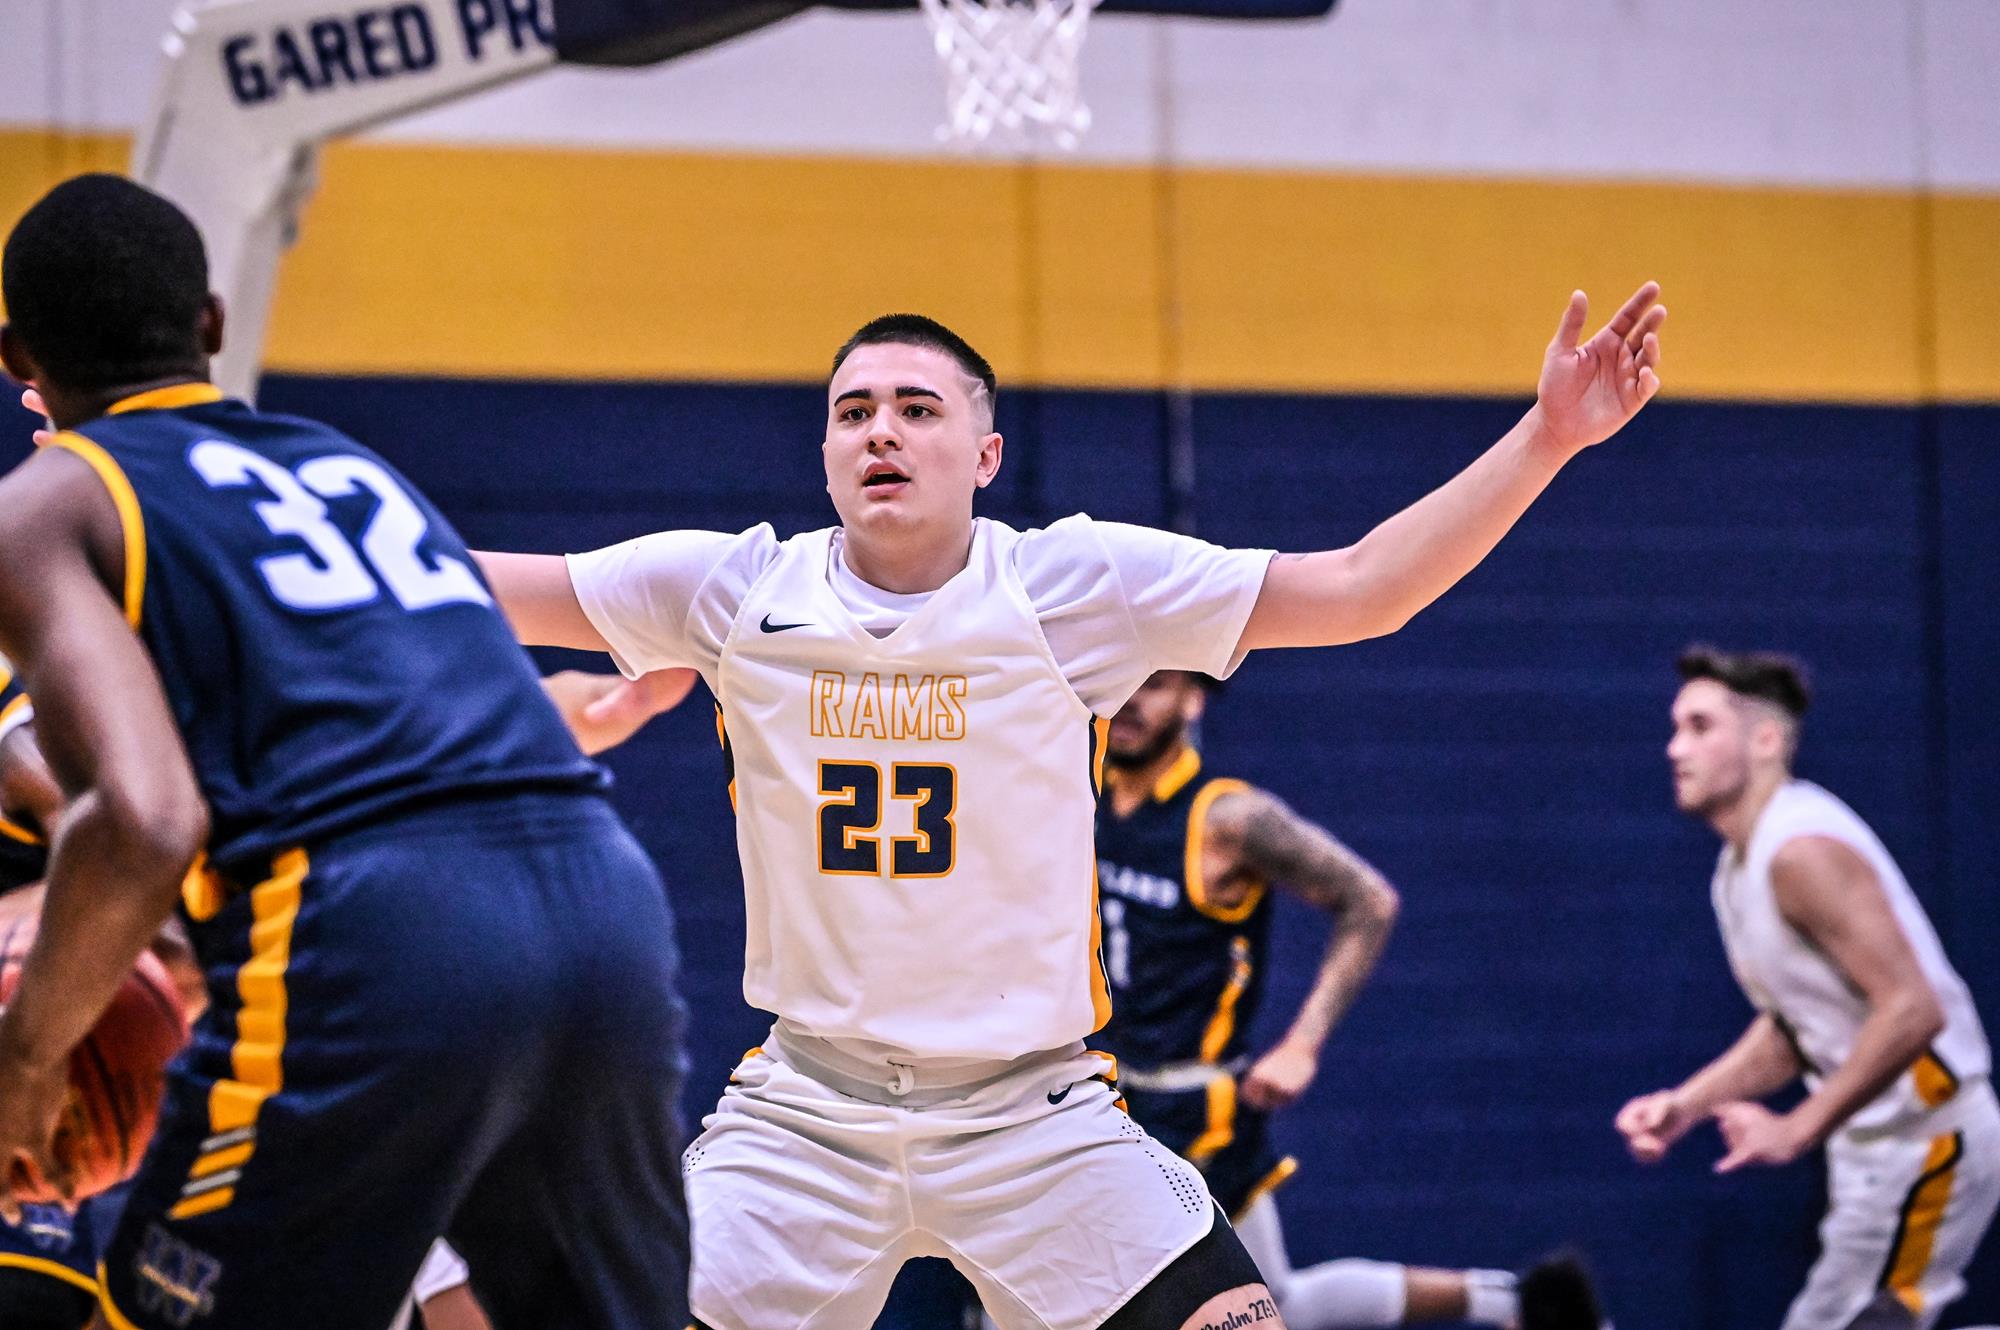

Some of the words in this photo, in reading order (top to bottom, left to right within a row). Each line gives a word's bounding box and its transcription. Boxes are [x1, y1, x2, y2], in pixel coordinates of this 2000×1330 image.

[222, 5, 438, 106] GARED
[188, 440, 494, 612] 32
[810, 670, 967, 741] RAMS
[816, 758, 958, 879] 23
[1248, 1299, 1277, 1321] 27:1
